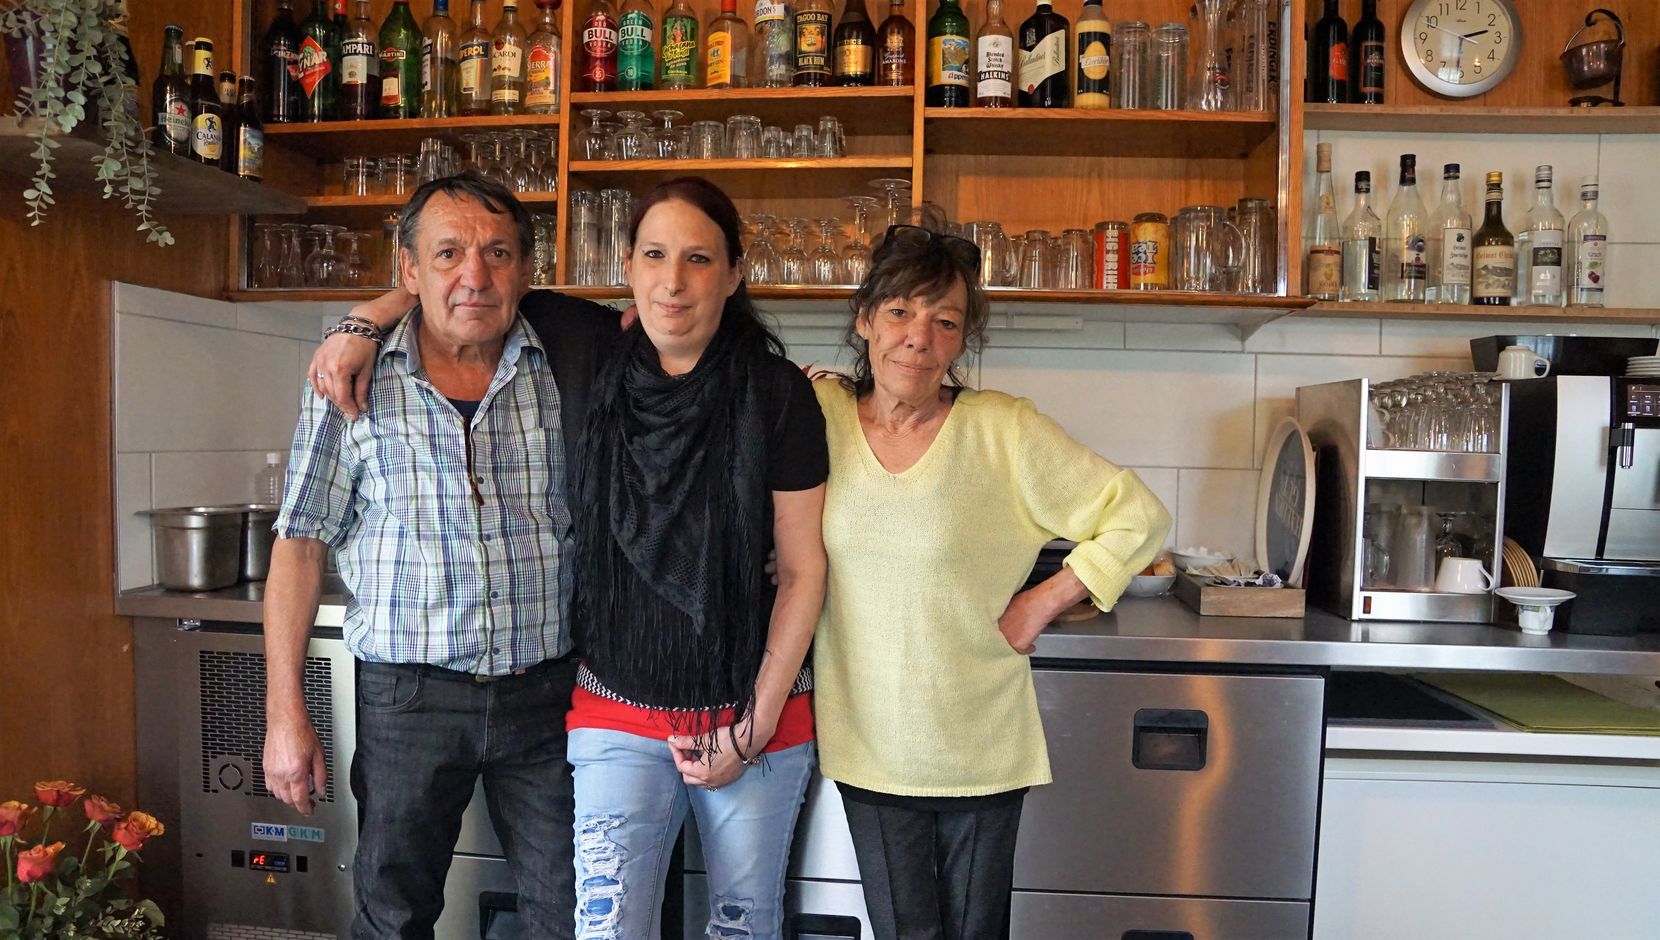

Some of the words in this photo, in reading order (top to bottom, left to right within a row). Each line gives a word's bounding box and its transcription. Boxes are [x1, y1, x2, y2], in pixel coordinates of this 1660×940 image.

[1438, 3, 1450, 16] 11
[1425, 15, 1439, 29] 10
[1487, 13, 1496, 27] 2
[587, 28, 614, 42] BULL
[620, 26, 647, 39] BULL
[1419, 31, 1428, 45] 9
[1494, 31, 1502, 45] 3
[1425, 49, 1434, 63] 8
[1487, 48, 1495, 62] 4
